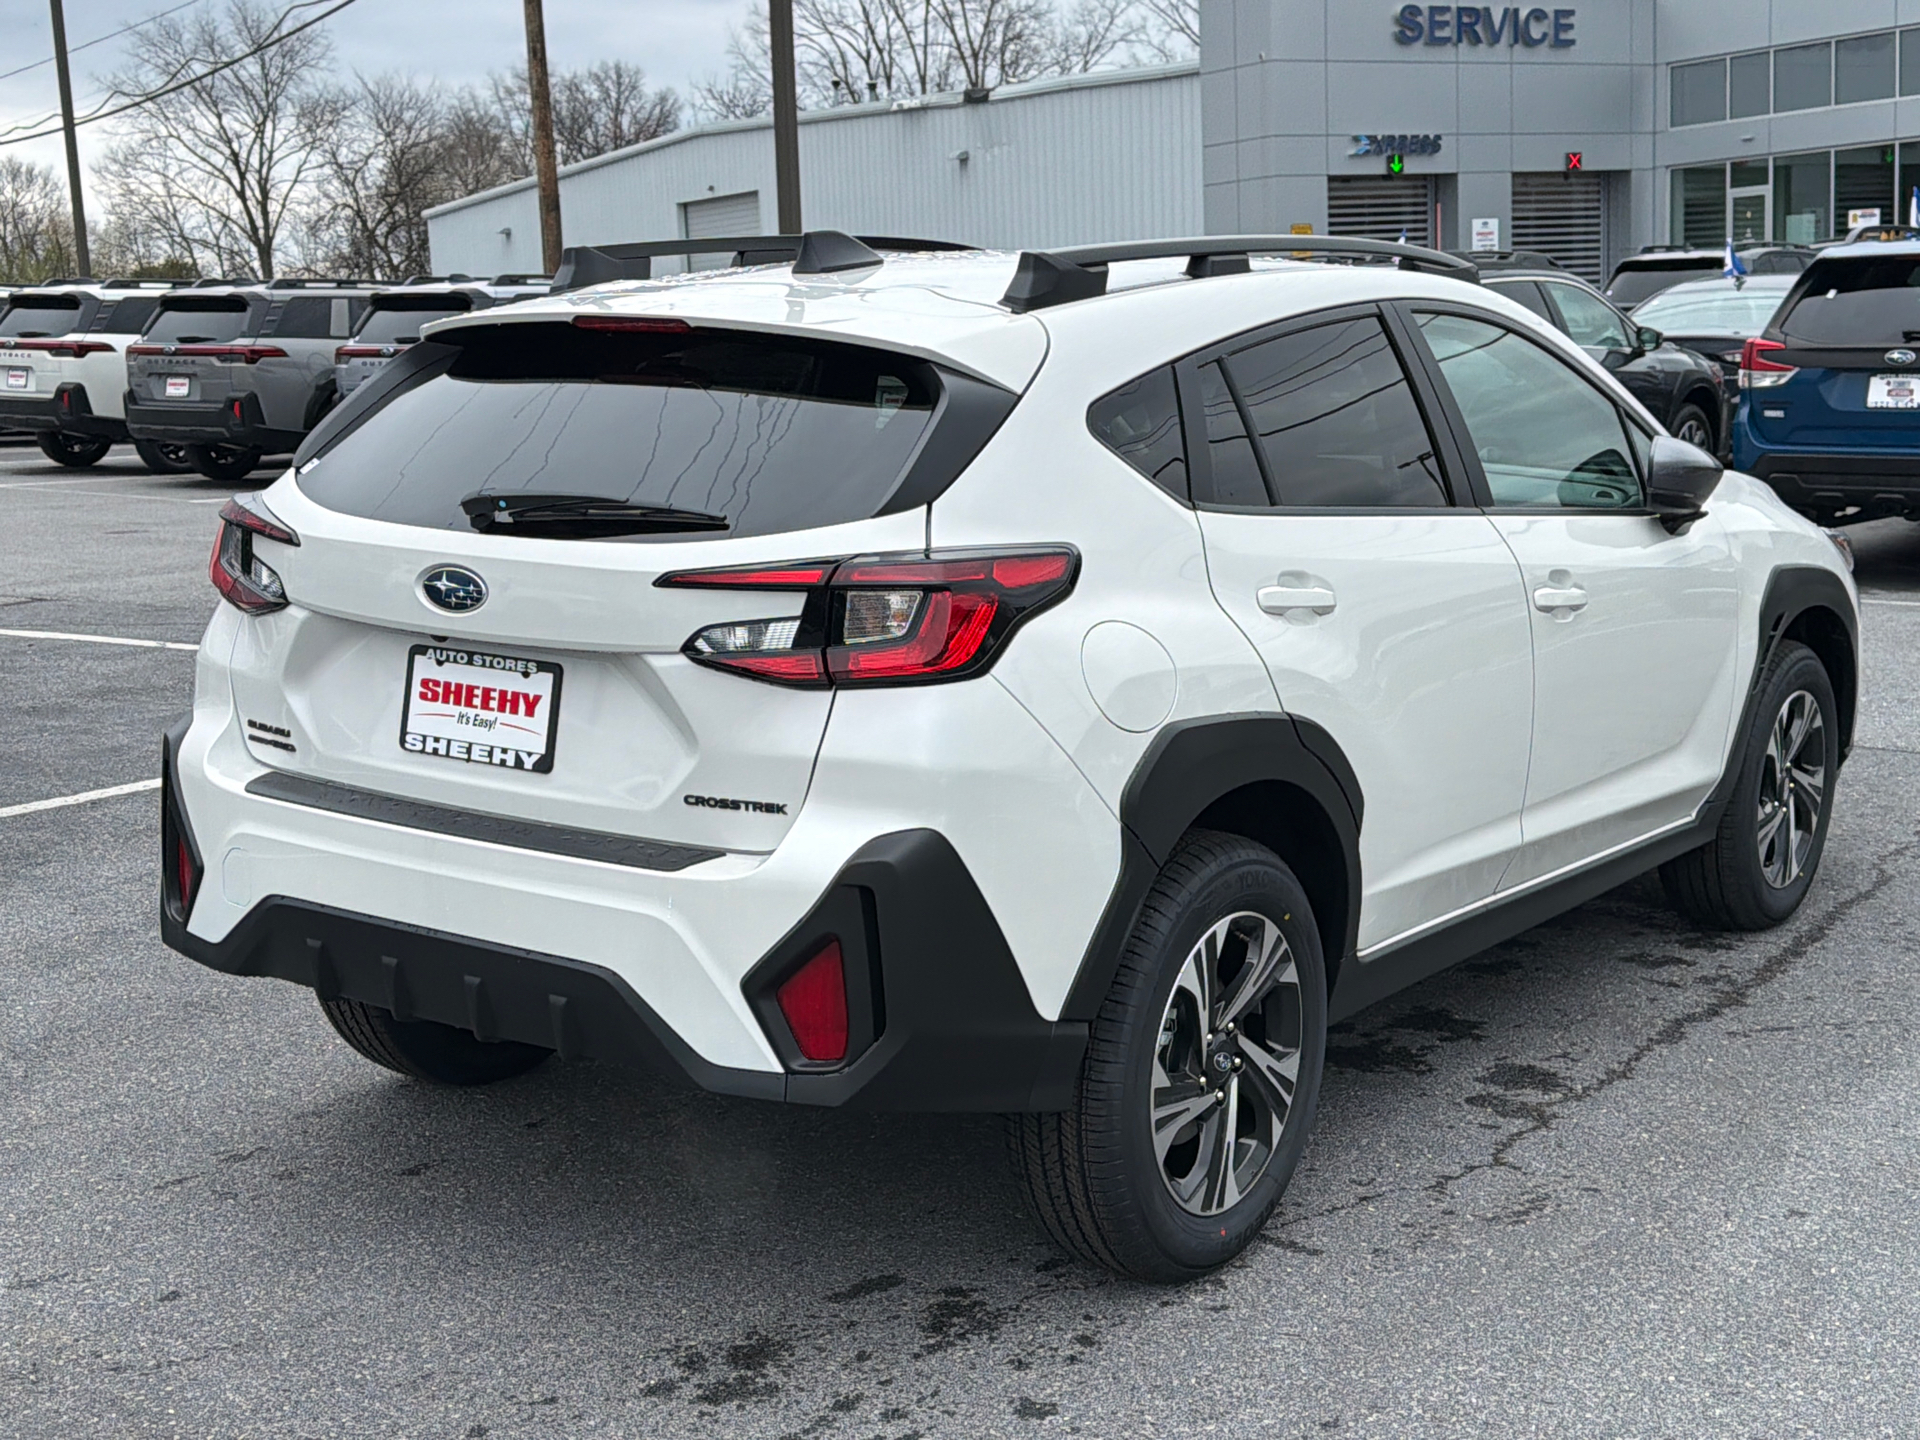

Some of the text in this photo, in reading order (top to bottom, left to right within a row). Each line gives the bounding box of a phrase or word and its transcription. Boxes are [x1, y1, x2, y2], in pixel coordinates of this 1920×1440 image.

[1395, 4, 1577, 48] SERVICE
[425, 648, 538, 674] AUTO STORES
[418, 677, 543, 718] SHEEHY
[456, 711, 498, 732] It's Easy!
[404, 733, 542, 770] SHEEHY
[683, 794, 788, 816] CROSSTREK
